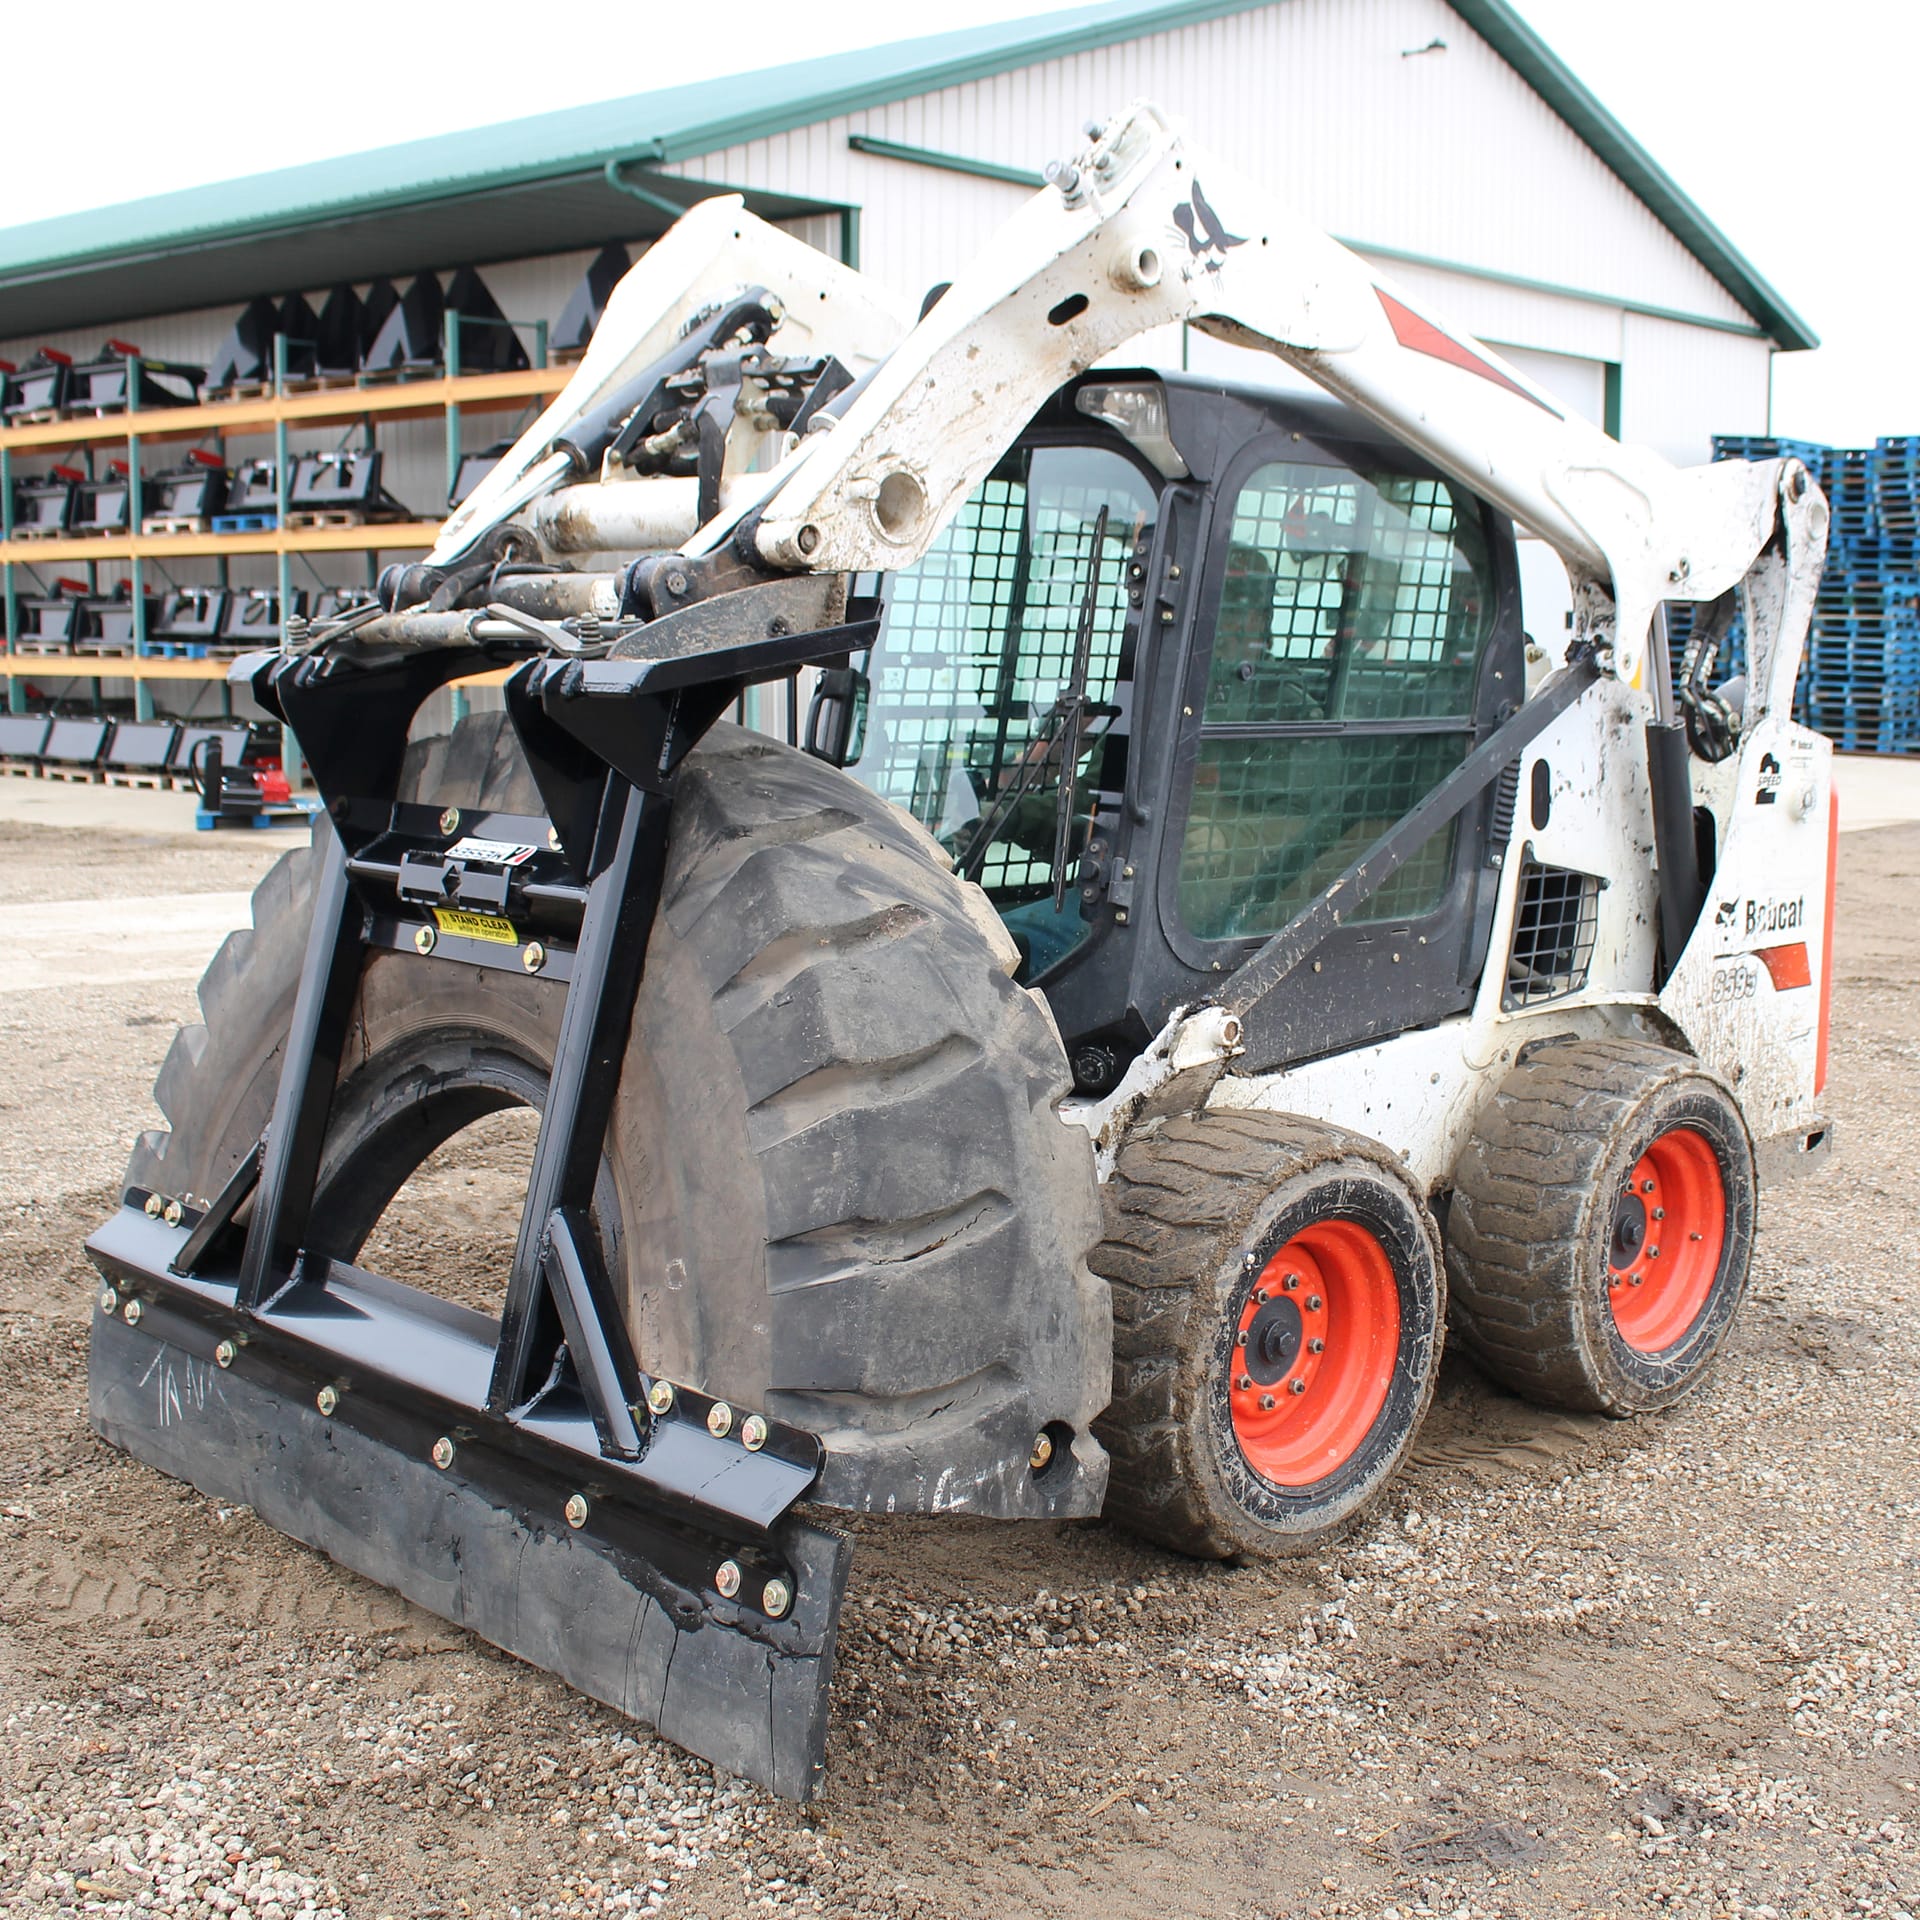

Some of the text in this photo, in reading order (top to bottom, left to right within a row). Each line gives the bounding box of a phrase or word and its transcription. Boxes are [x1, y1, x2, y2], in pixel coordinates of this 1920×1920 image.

[1756, 775, 1782, 787] SPEED
[449, 913, 511, 932] STAND CLEAR
